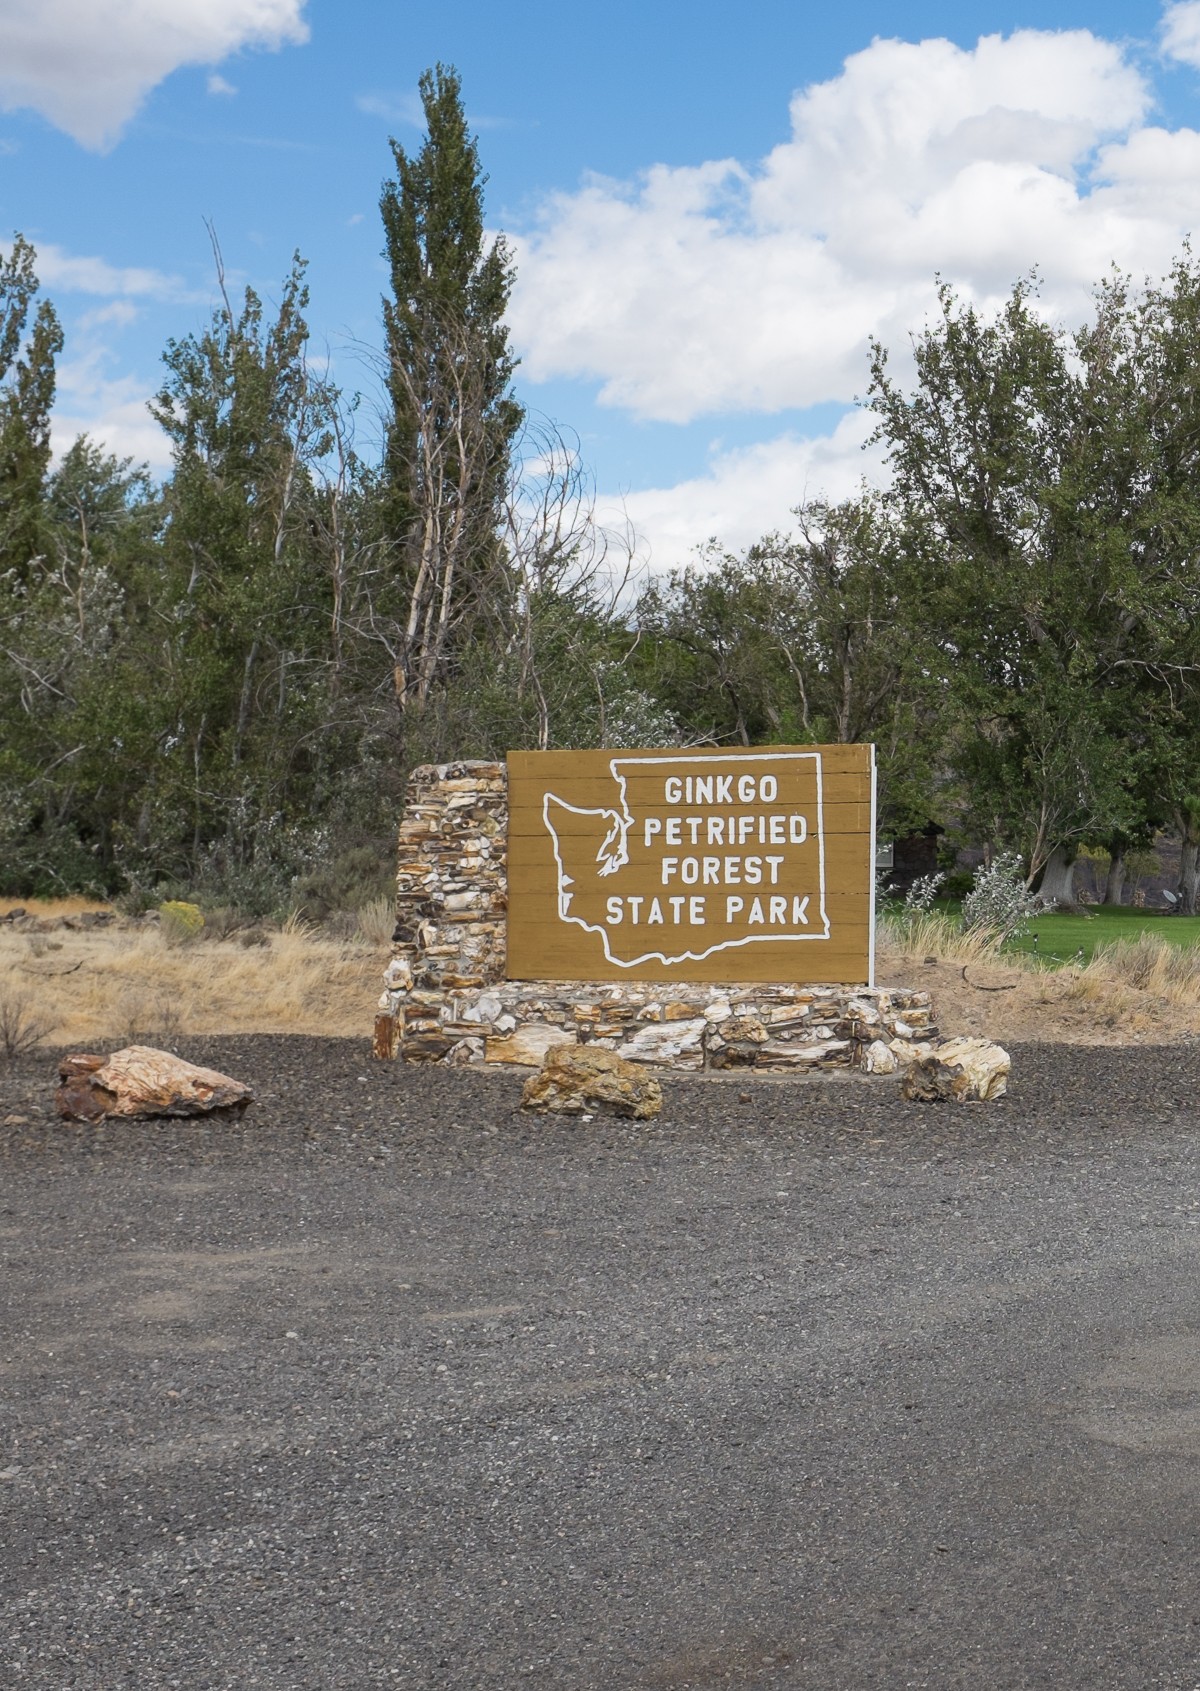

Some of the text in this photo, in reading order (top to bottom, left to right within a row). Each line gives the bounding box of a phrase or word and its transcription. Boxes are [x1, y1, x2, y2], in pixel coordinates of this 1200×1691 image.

[665, 775, 778, 805] GINKGO
[644, 815, 807, 847] PETRIFIED
[661, 855, 785, 885] FOREST
[606, 895, 810, 925] STATE PARK
